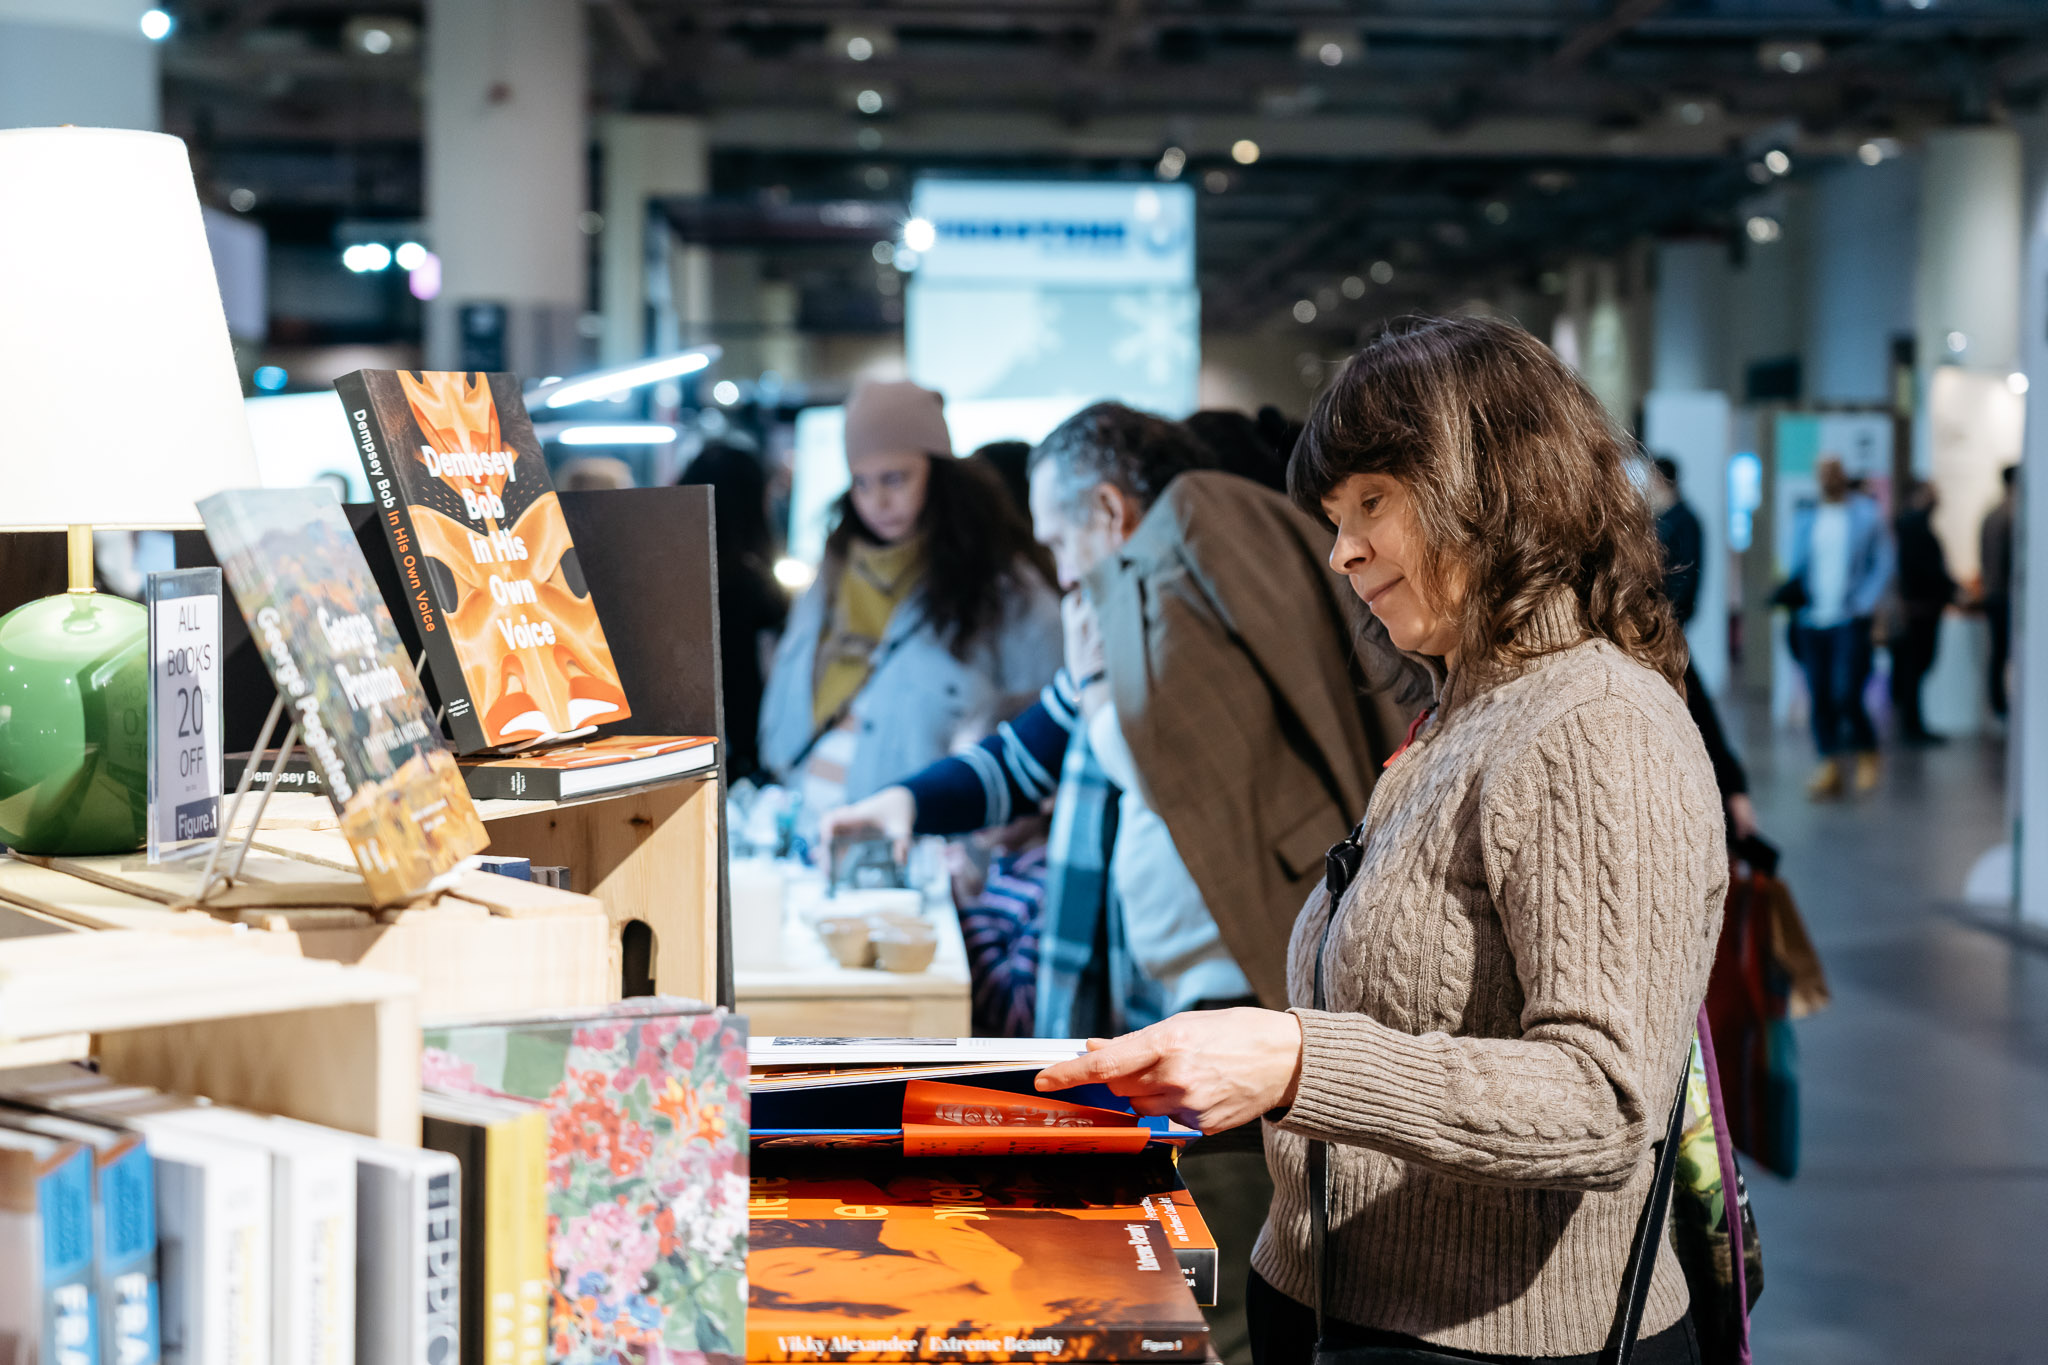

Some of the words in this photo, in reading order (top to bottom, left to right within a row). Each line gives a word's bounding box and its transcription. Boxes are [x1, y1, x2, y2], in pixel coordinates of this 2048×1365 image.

[353, 409, 384, 477] Dempsey
[421, 445, 517, 484] Dempsey
[377, 479, 396, 509] Bob
[461, 485, 505, 520] Bob
[387, 510, 400, 527] In
[393, 528, 409, 554] His
[467, 531, 494, 564] In
[489, 528, 528, 562] His
[403, 555, 421, 590] Own
[489, 574, 537, 606] Own
[179, 603, 201, 633] ALL
[415, 590, 436, 632] Voice
[497, 614, 556, 650] Voice
[167, 644, 211, 676] BOOKS
[257, 607, 306, 697] George
[295, 694, 353, 803] Paginton
[179, 746, 204, 778] OFF
[178, 804, 217, 840] Figure.1
[1160, 1204, 1178, 1214] Coast
[1166, 1214, 1188, 1236] Northwest
[1124, 1224, 1150, 1245] Beauty
[1136, 1245, 1161, 1271] Extreme
[777, 1335, 827, 1357] Vikky
[829, 1335, 919, 1353] Alexander
[929, 1335, 1001, 1353] Extreme
[1003, 1335, 1064, 1356] Beauty
